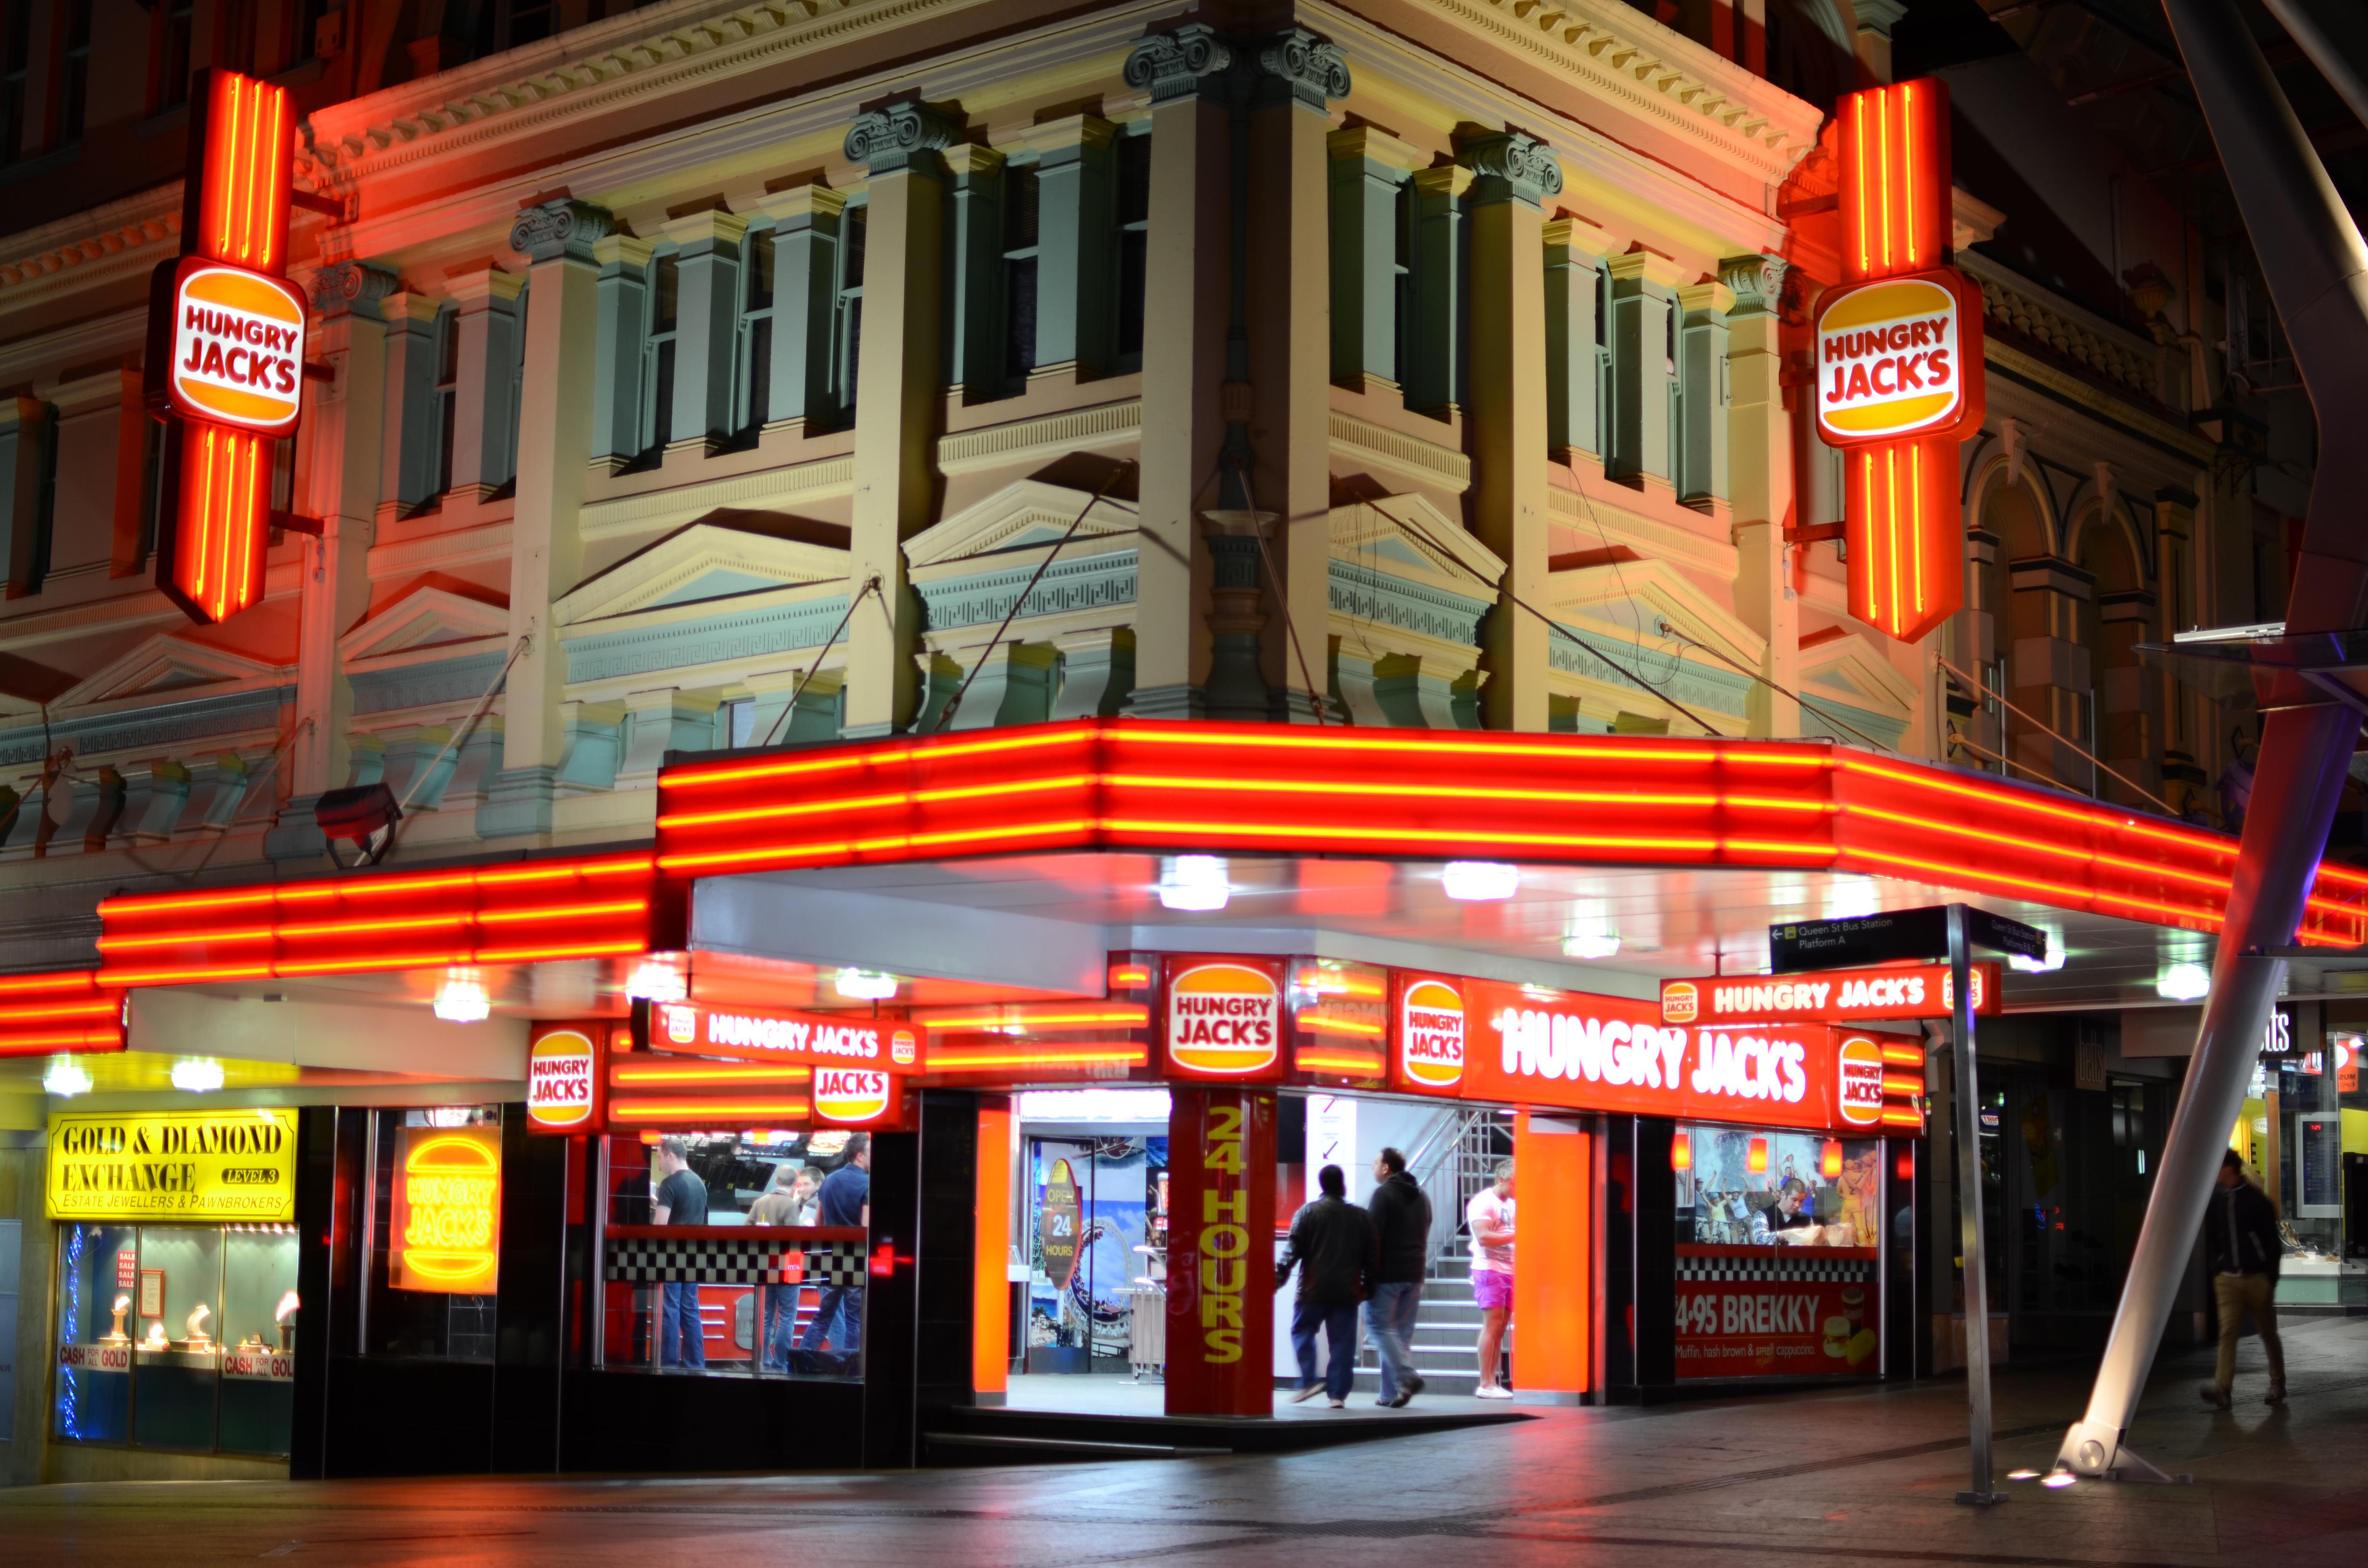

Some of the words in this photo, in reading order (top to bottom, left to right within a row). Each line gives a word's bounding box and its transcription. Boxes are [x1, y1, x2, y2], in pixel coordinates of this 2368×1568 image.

[185, 305, 298, 354] HUNGRY
[1825, 317, 1949, 364] HUNGRY
[183, 337, 296, 394] JACK'S
[1826, 349, 1951, 404] JACK'S
[1799, 925, 1829, 936] Queen
[1831, 923, 1840, 932] St
[1843, 921, 1859, 931] Bus
[1861, 918, 1893, 929] Station
[1799, 937, 1836, 949] Platform
[1838, 936, 1846, 944] A
[1665, 994, 1694, 1003] HUNGRY
[1715, 982, 1830, 1013] HUNGRY
[1838, 977, 1924, 1007] JACK'S
[1177, 997, 1272, 1017] HUNGRY
[1176, 1018, 1272, 1046] JACK'S
[1409, 1011, 1462, 1032] HUNGRY
[709, 1014, 810, 1051] HUNGRY
[811, 1025, 878, 1058] JACK'S
[1409, 1032, 1462, 1060] JACK'S
[1502, 1007, 1687, 1090] HUNGRY
[1691, 1031, 1806, 1102] JACK'S
[2079, 1017, 2102, 1084] betts
[533, 1059, 589, 1076] HUNGRY
[1844, 1063, 1882, 1080] HUNGRY
[532, 1078, 589, 1102] JACK'S
[63, 1126, 126, 1157] GOLD
[132, 1125, 153, 1155] &
[160, 1124, 283, 1155] DIAMOND
[1205, 1106, 1247, 1175] 24
[61, 1162, 196, 1193] EXCHANGE
[227, 1169, 267, 1183] LEVEL
[267, 1169, 276, 1183] 3
[63, 1194, 104, 1207] ESTATE
[107, 1194, 174, 1208] JEWELLERS
[177, 1195, 185, 1208] &
[191, 1195, 283, 1209] PAWNBROKERS
[407, 1177, 496, 1206] HUNGRY
[1048, 1189, 1073, 1203] OPEN
[1053, 1214, 1072, 1237] 24
[1046, 1245, 1073, 1256] HOURS
[1200, 1190, 1250, 1363] HOURS
[1723, 1294, 1821, 1334] BREKKY
[60, 1347, 85, 1365] CASH
[101, 1349, 127, 1368] GOLD
[256, 1358, 269, 1366] FOR
[1675, 1344, 1702, 1359] Muffin,
[1704, 1344, 1720, 1358] hash
[1722, 1344, 1746, 1357] brown
[1748, 1344, 1754, 1356] &
[1756, 1342, 1774, 1356] small
[1776, 1343, 1815, 1360] cappuccino.
[225, 1356, 253, 1375] CASH
[256, 1368, 268, 1376] ALL
